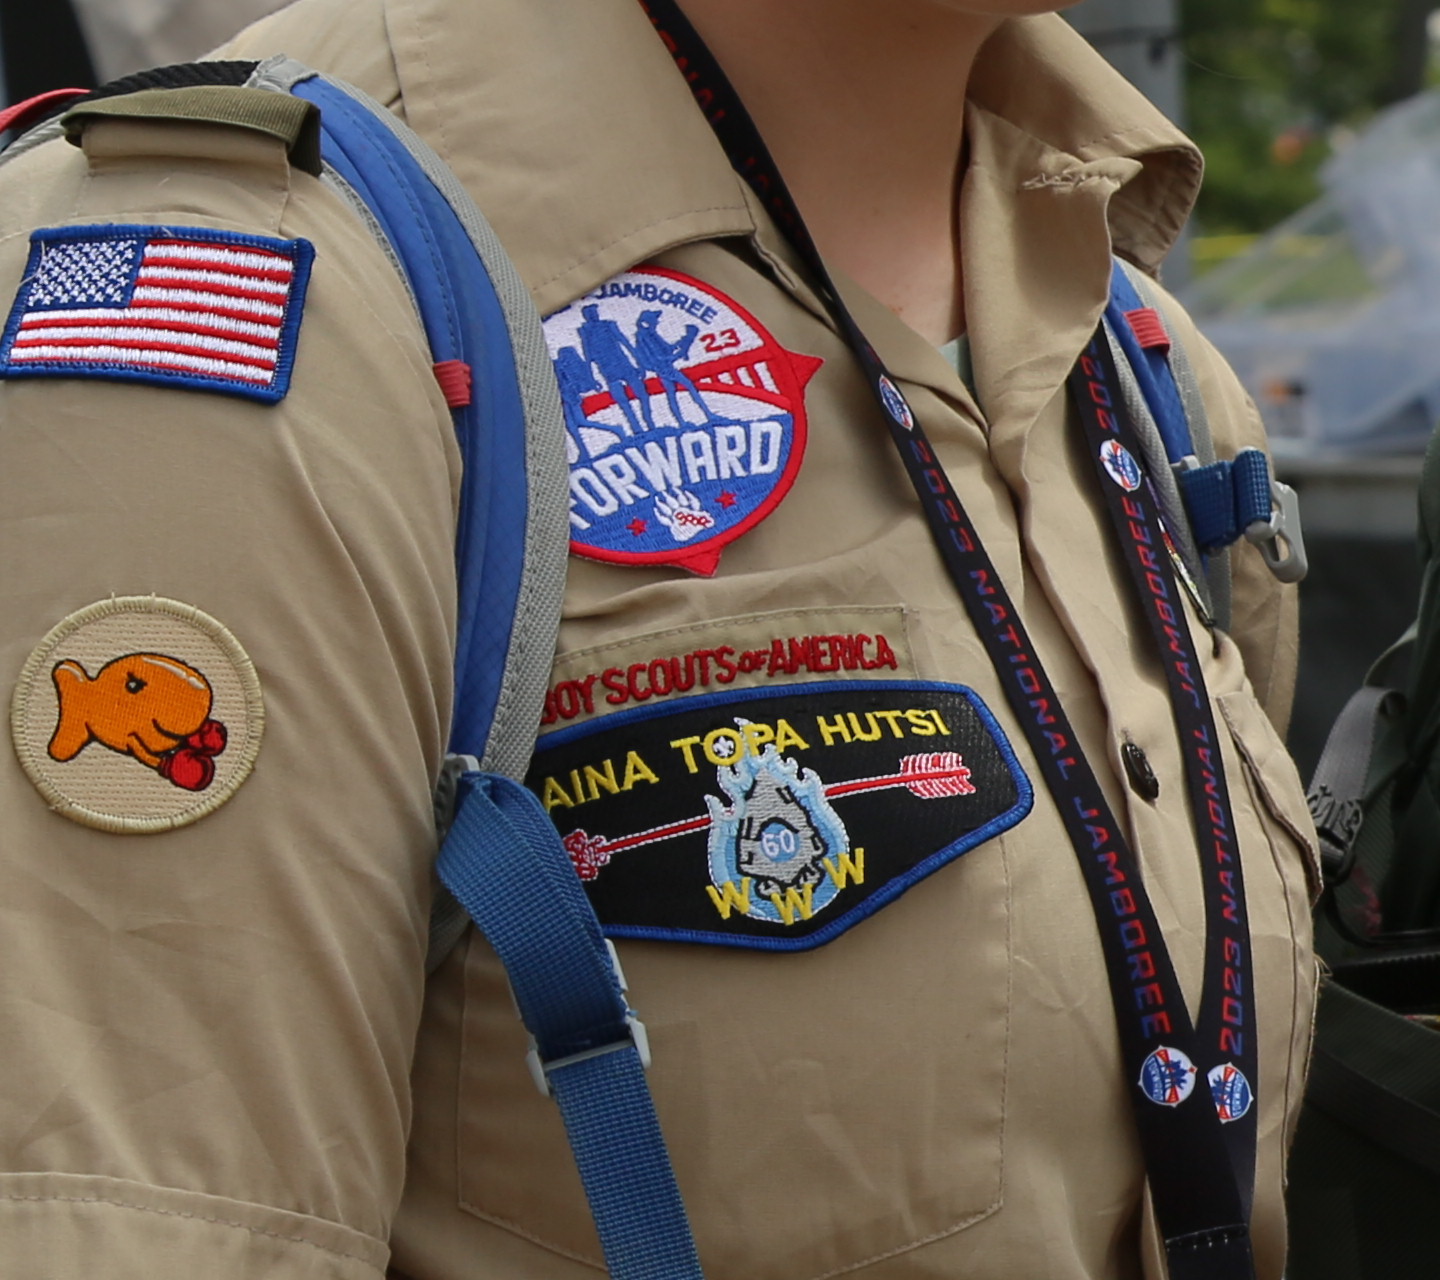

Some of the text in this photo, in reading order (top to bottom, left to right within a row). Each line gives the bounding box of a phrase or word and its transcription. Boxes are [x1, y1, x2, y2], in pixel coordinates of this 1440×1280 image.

[596, 283, 718, 325] JAMBOREE
[699, 329, 741, 353] 23
[602, 646, 737, 705] SCOUTS
[768, 633, 897, 676] AMERICA
[542, 708, 952, 814] AINA TOPA HUTSI
[910, 438, 1172, 1037] 2023 NATIONAL JAMBOREE
[1131, 495, 1243, 1056] 2023 NATIONAL JAMBOREE
[760, 827, 796, 856] 60
